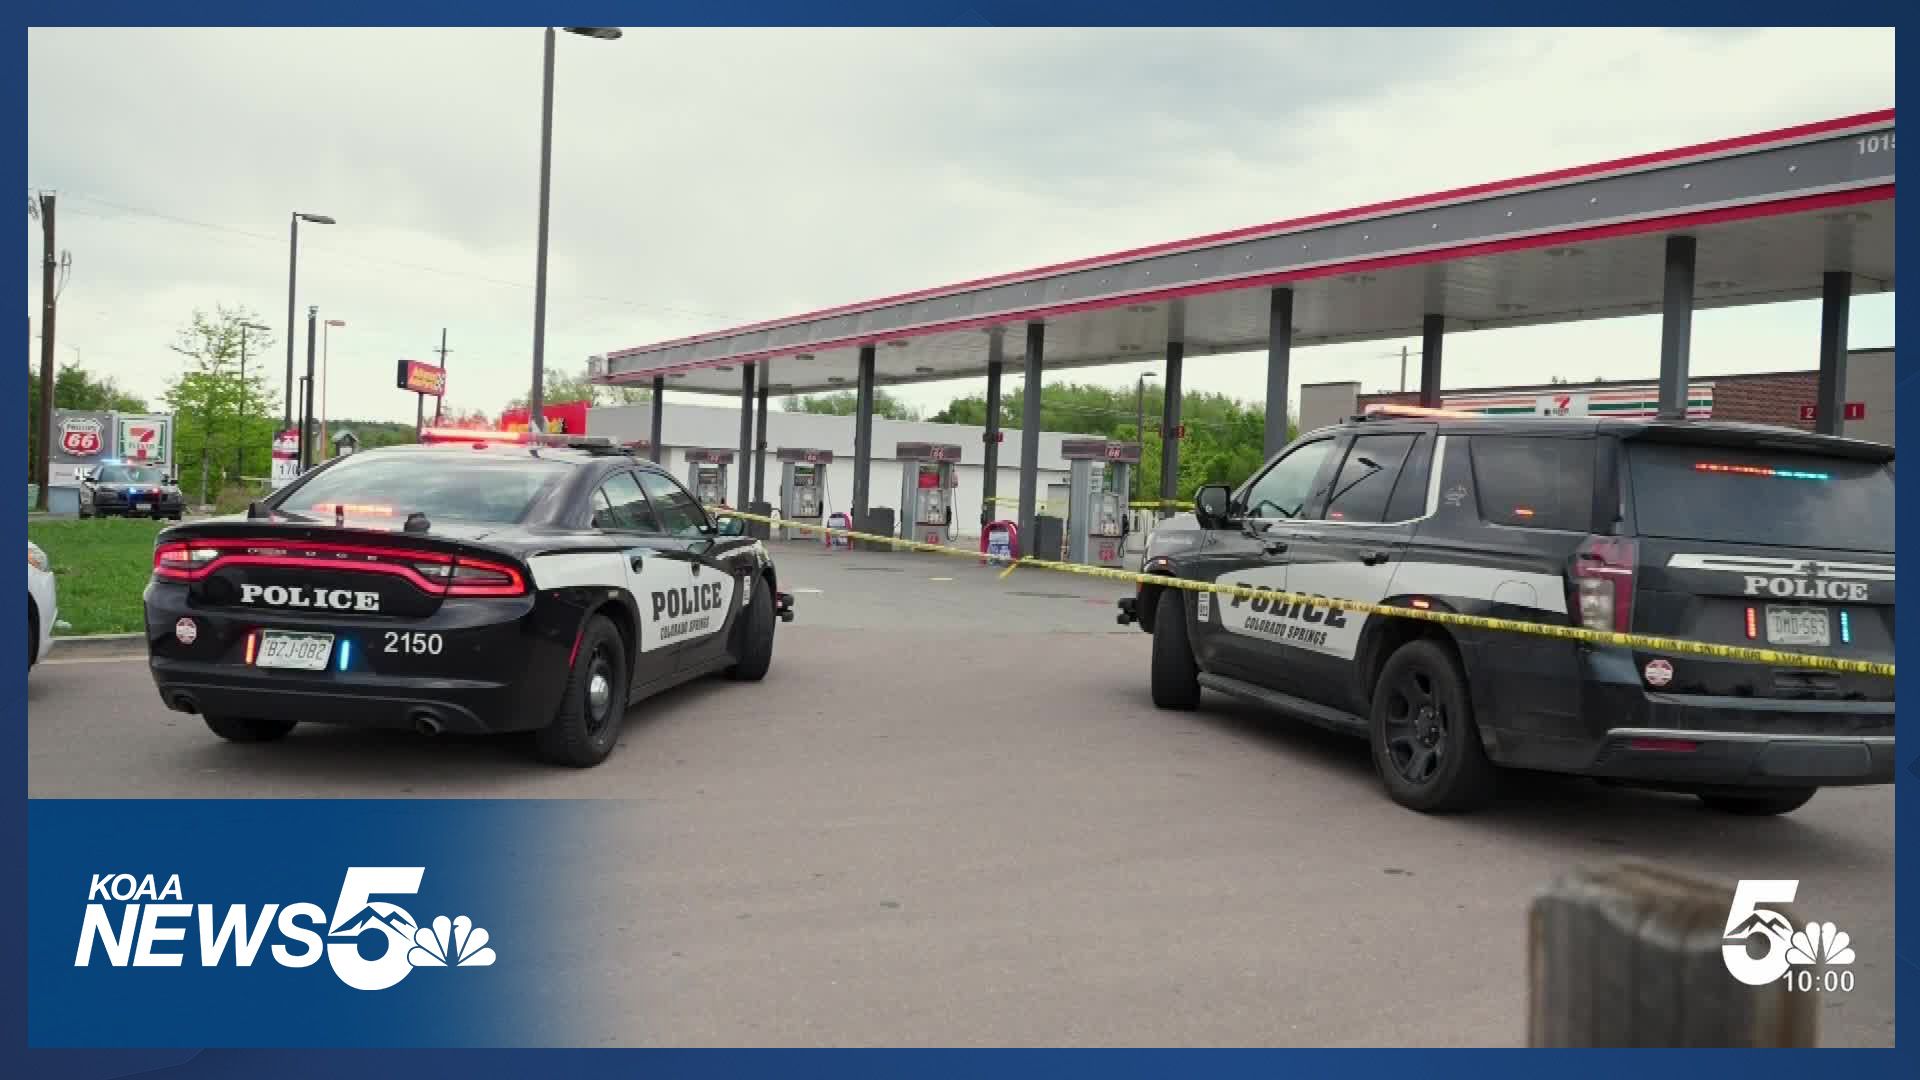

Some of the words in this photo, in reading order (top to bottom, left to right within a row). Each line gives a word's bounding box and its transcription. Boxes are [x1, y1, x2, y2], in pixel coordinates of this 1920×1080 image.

[1806, 407, 1815, 419] 2
[68, 433, 96, 448] 66
[240, 583, 380, 611] POLICE
[1744, 575, 1869, 601] POLICE
[651, 582, 722, 622] POLICE
[660, 622, 689, 641] COLORADO
[689, 615, 710, 633] SPRINGS
[1244, 615, 1287, 637] COLORADO
[1287, 626, 1328, 646] SPRINGS
[383, 631, 443, 655] 2150
